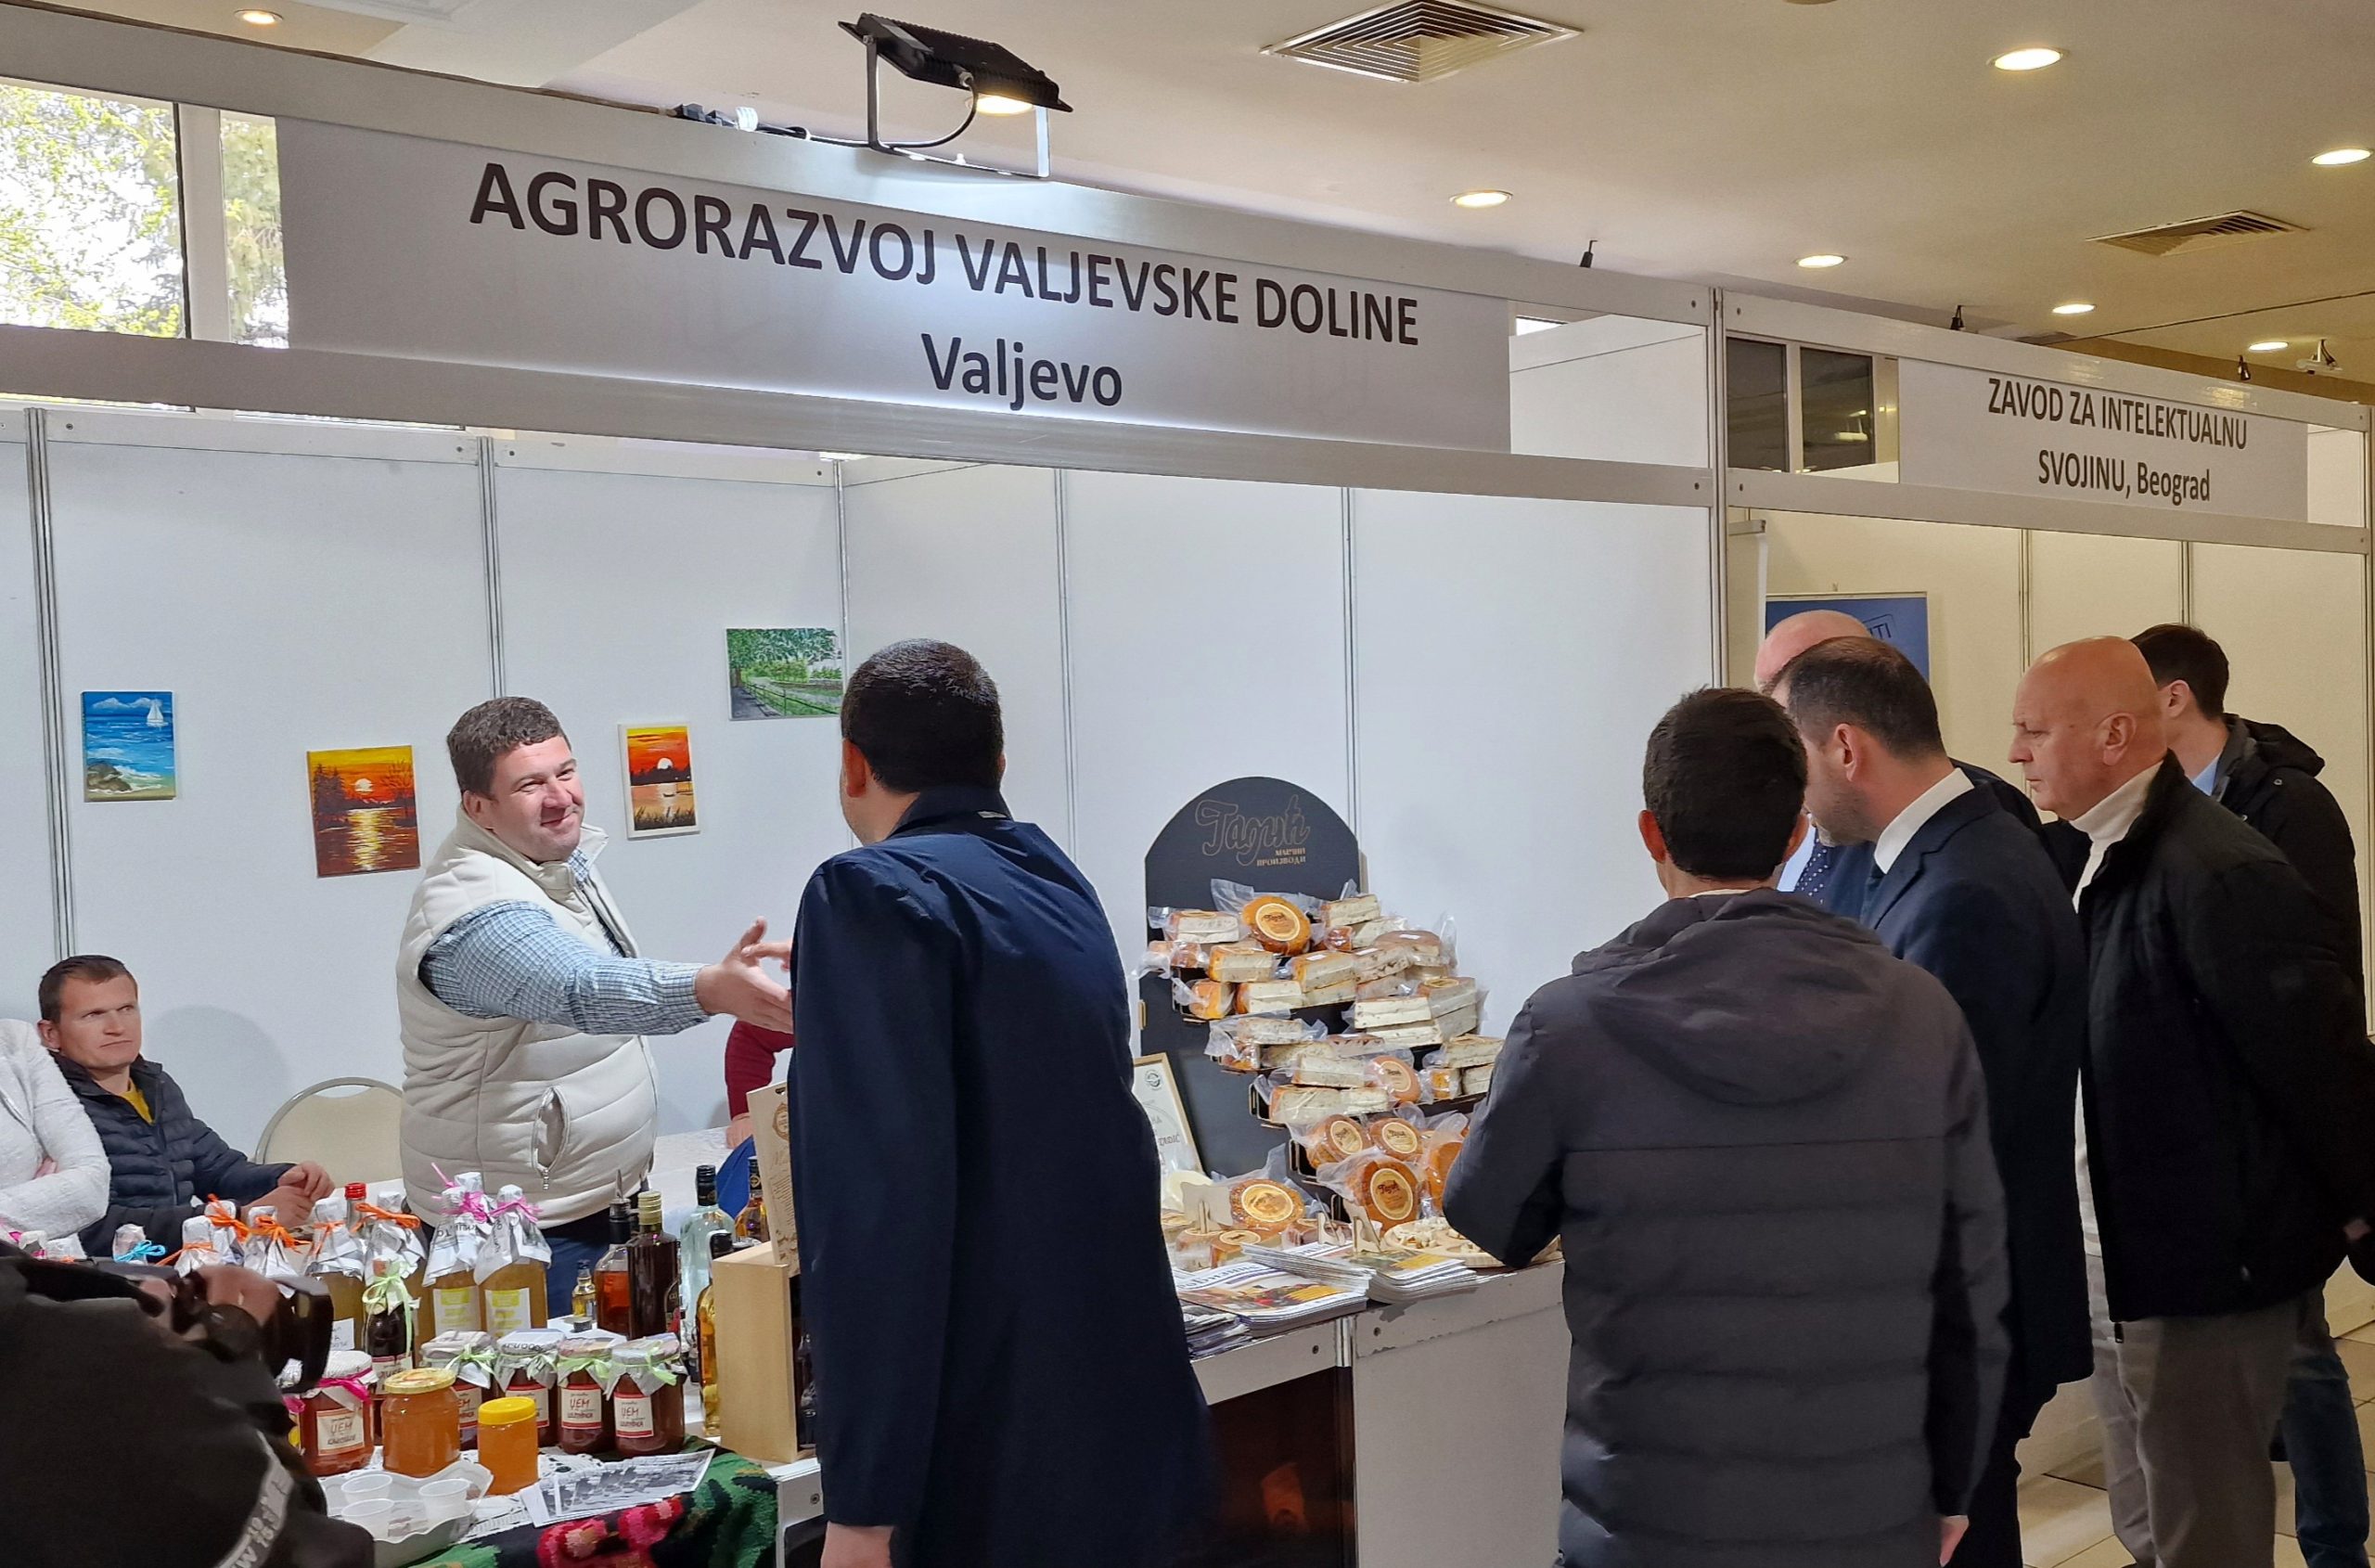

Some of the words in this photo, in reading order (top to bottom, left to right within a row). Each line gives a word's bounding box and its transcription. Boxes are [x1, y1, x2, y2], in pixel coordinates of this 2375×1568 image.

[469, 162, 937, 286] AGRORAZVOJ
[955, 234, 1239, 325] VALJEVSKE
[1256, 277, 1419, 346] DOLINE
[921, 333, 1123, 411] Valjevo
[1988, 378, 2063, 422] ZAVOD
[2070, 391, 2096, 427] ZA
[2101, 396, 2247, 450] INTELEKTUALNU
[2038, 449, 2131, 499] SVOJINU,
[2137, 462, 2211, 507] Beograd
